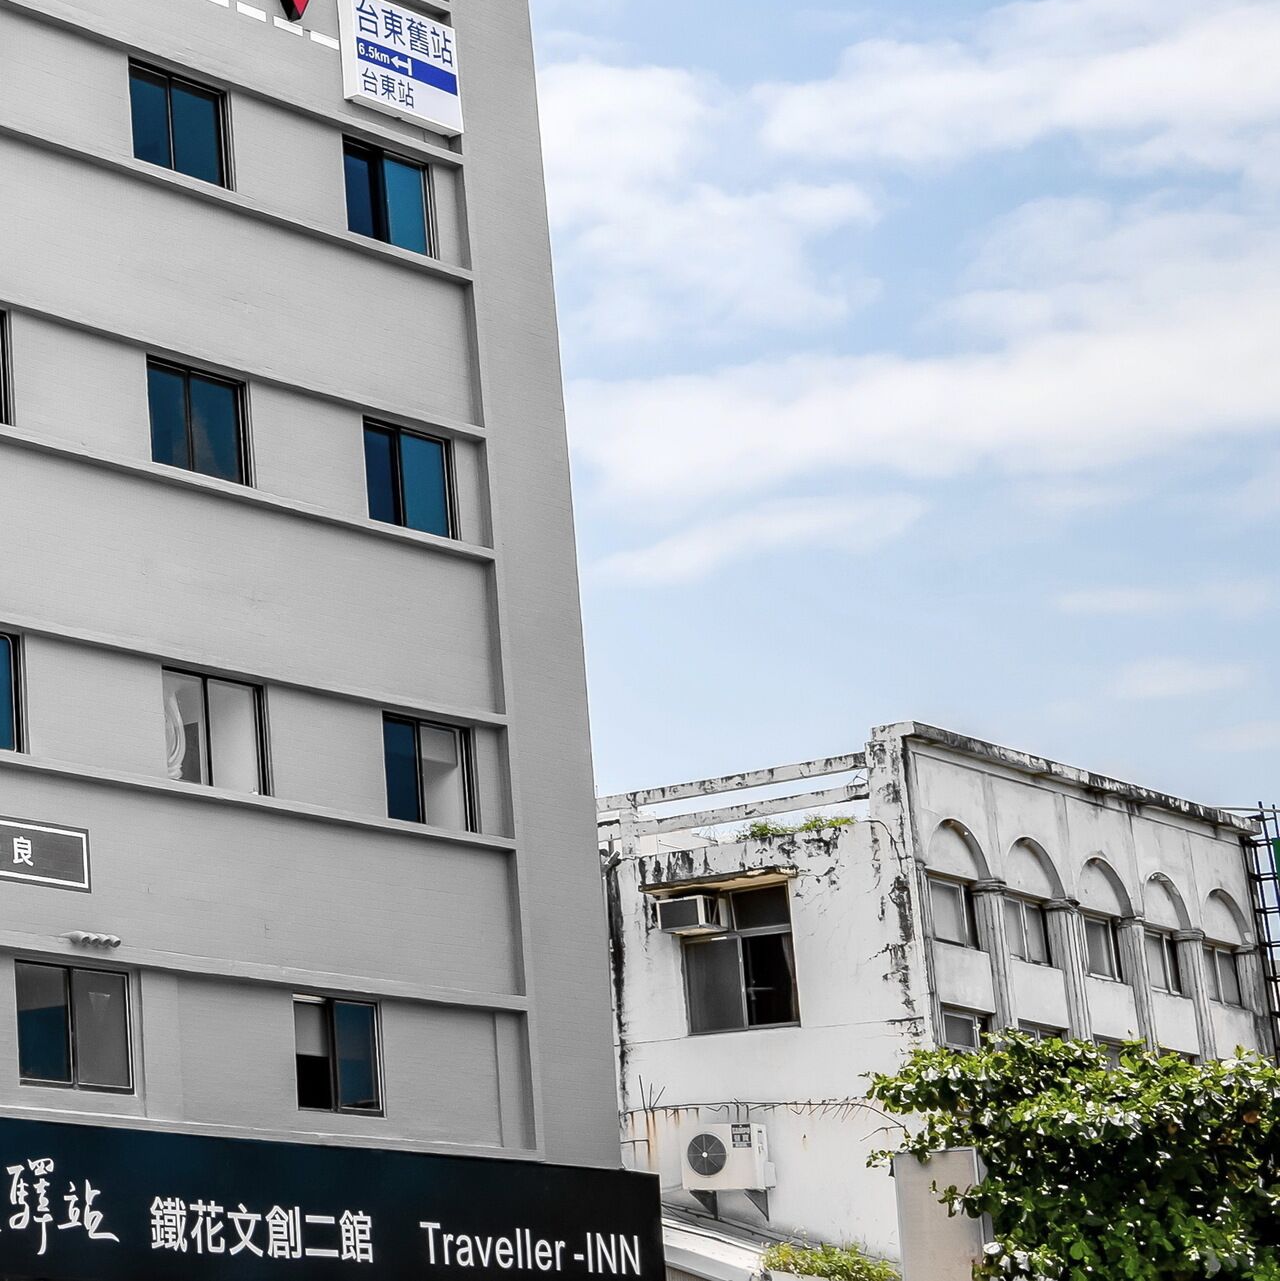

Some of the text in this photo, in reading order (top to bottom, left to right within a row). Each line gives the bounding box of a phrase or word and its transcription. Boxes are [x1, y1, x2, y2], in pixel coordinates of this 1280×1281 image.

[356, 0, 454, 68] 台東舊站
[358, 42, 391, 65] 6.5km
[361, 67, 415, 109] 台東站
[150, 1195, 374, 1265] 鐵花文創二館
[420, 1221, 565, 1271] Traveller
